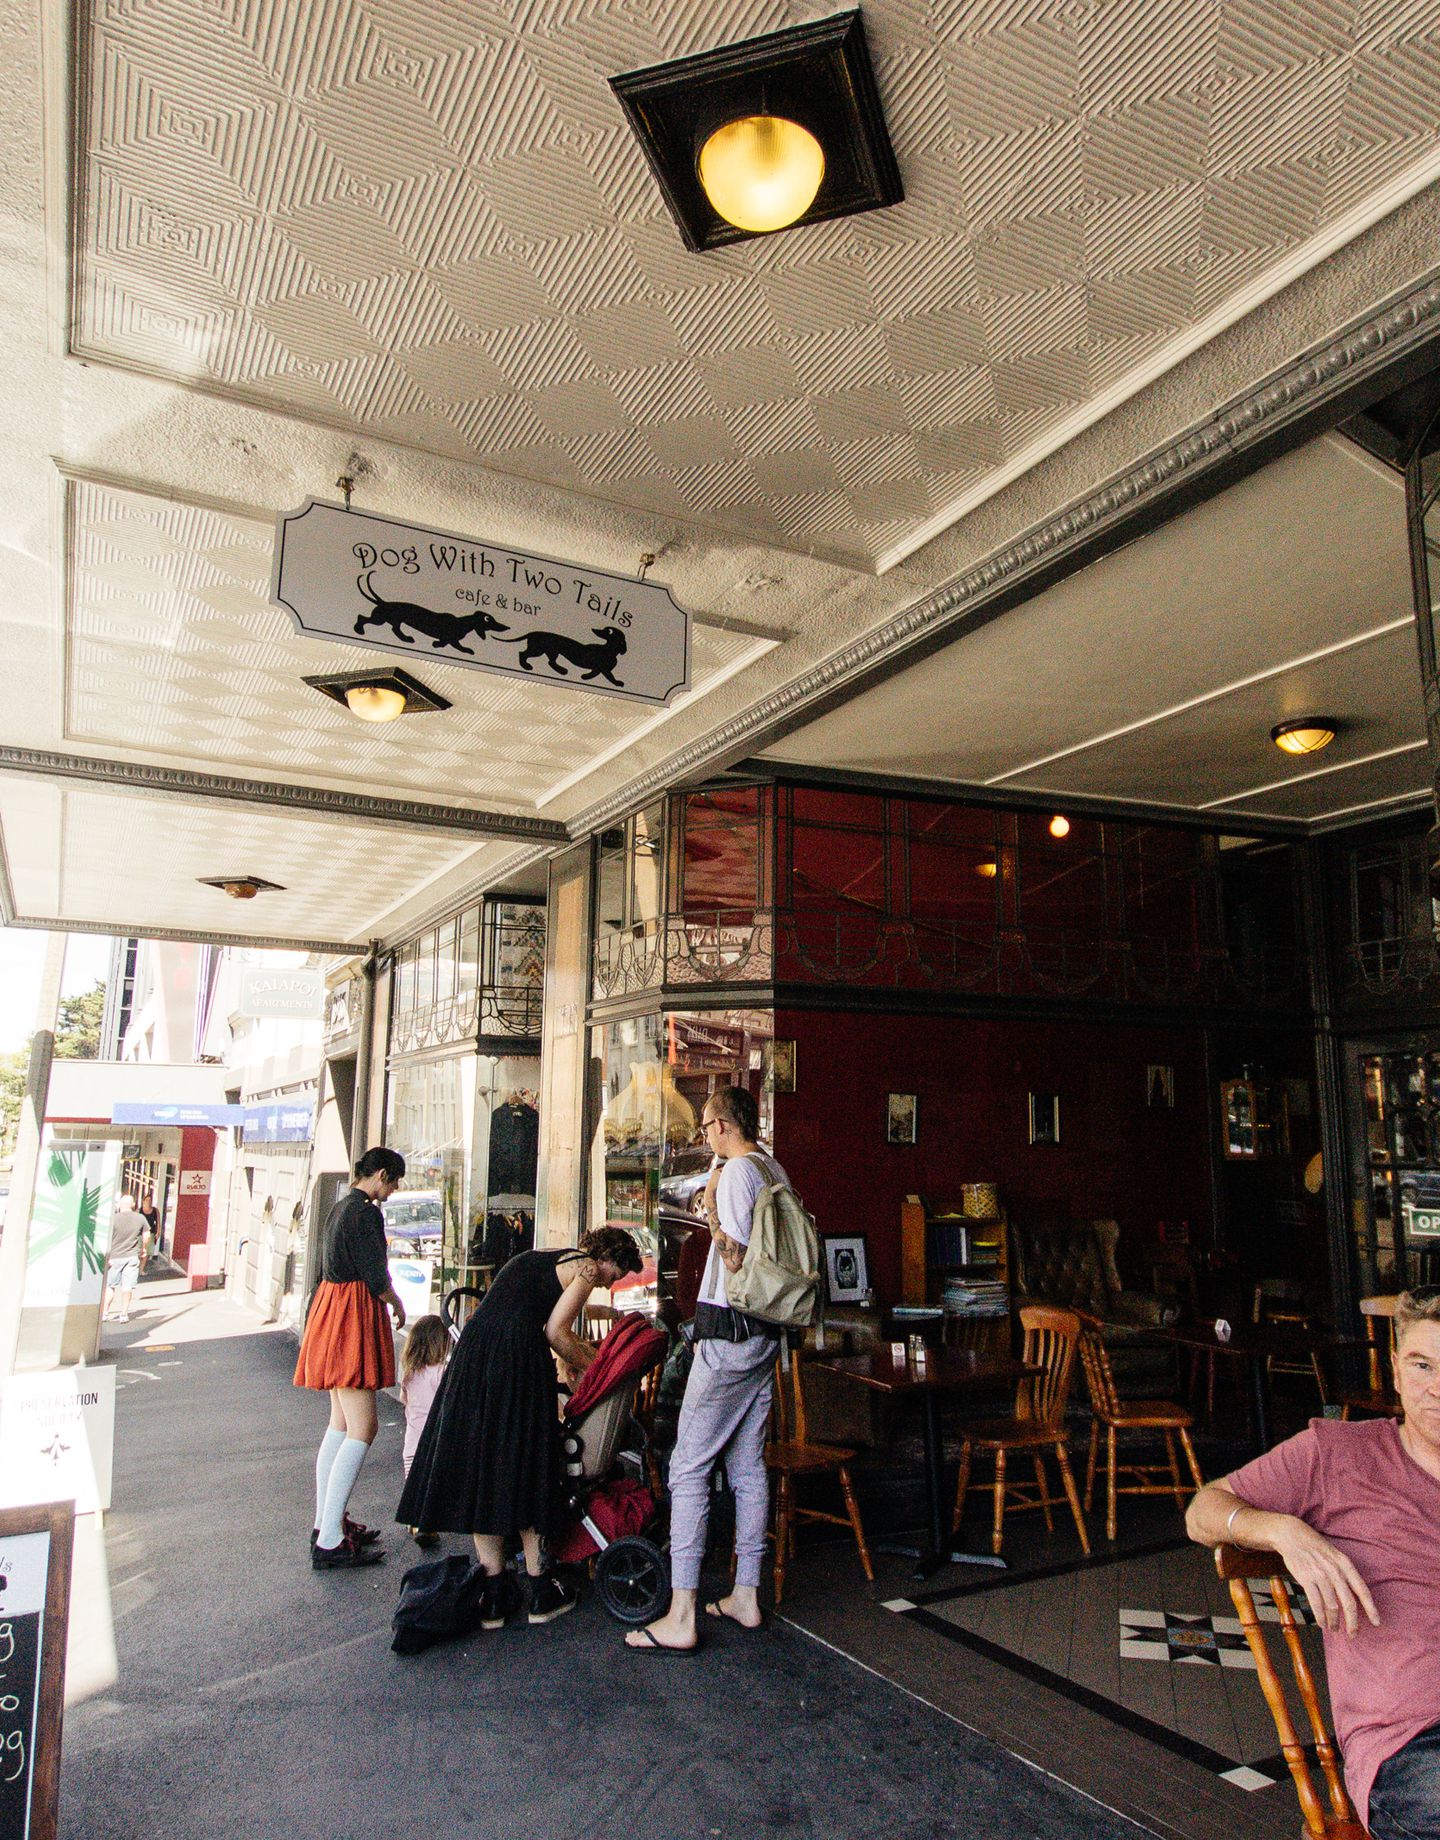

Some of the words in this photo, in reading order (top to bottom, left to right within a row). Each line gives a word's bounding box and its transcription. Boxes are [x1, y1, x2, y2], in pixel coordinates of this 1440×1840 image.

[352, 542, 420, 574] Dog
[429, 543, 495, 578] With
[506, 558, 562, 595] Two
[573, 579, 634, 628] Tails
[455, 587, 491, 607] cafe
[495, 593, 508, 610] &
[513, 597, 541, 616] bar
